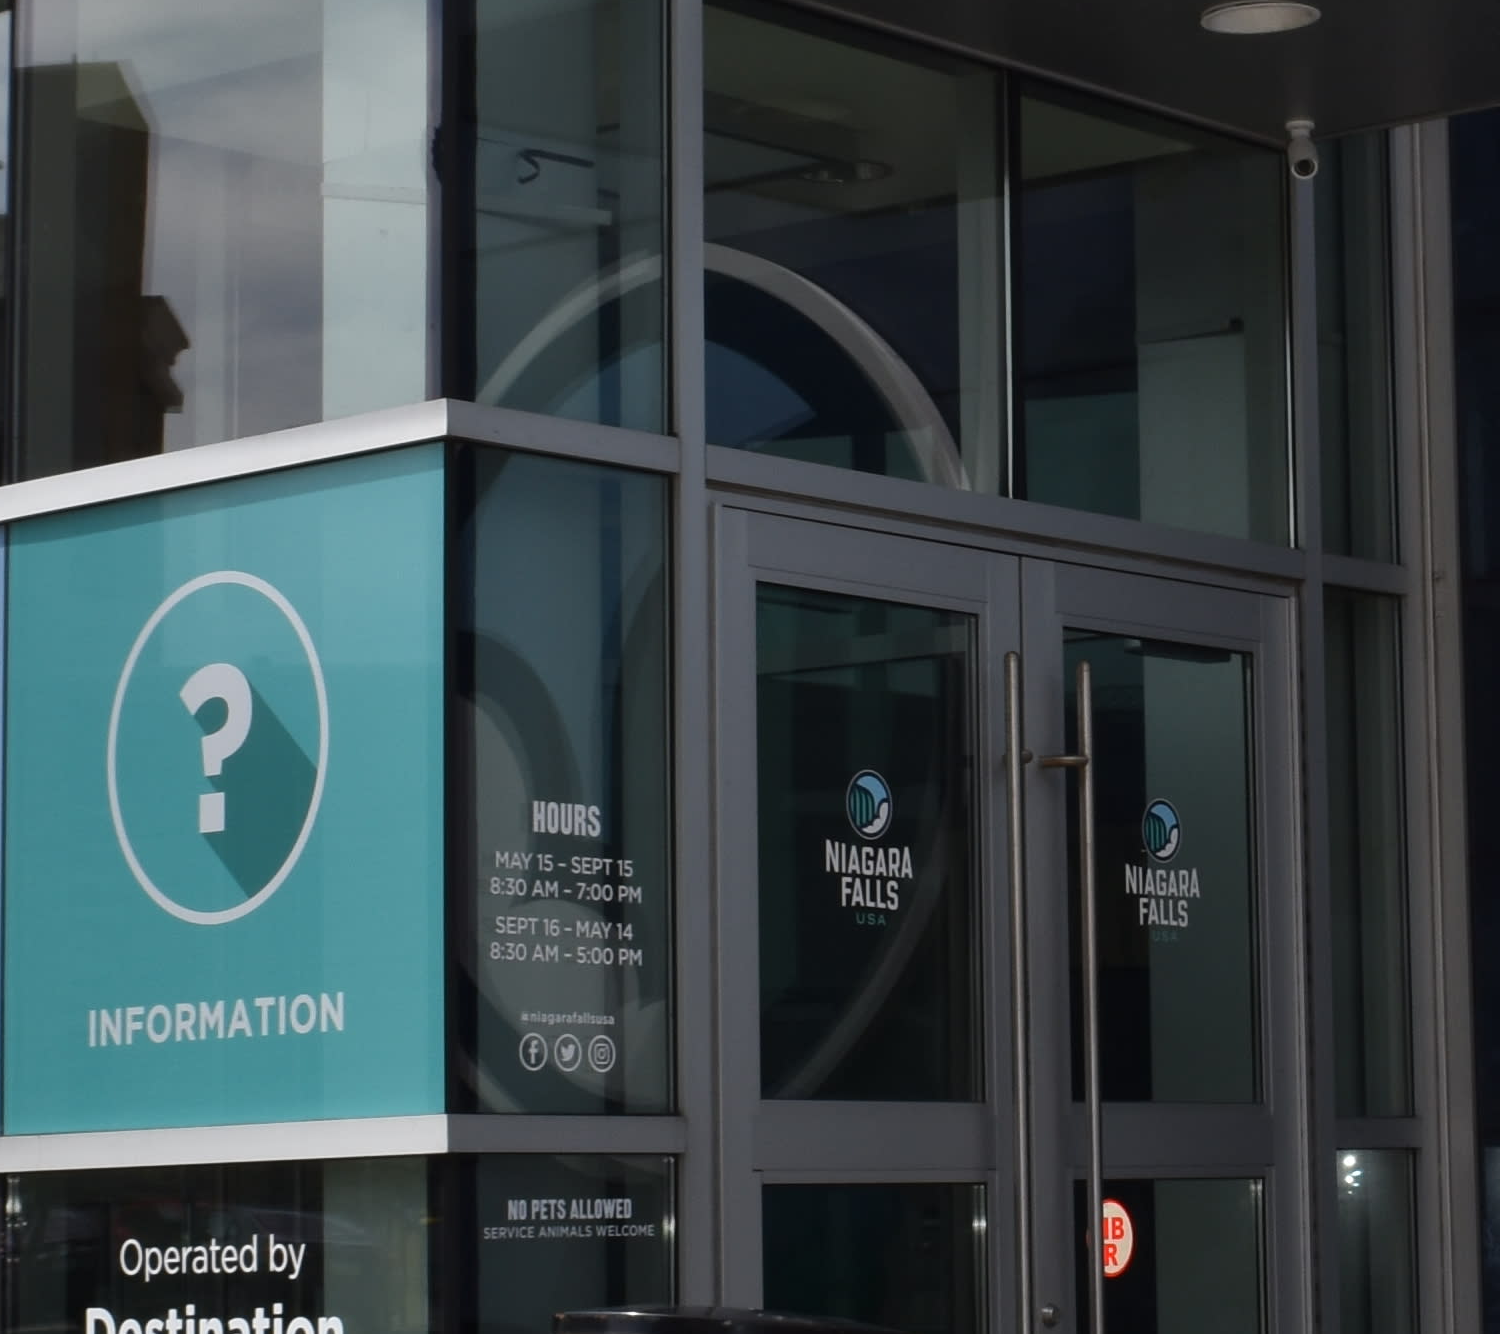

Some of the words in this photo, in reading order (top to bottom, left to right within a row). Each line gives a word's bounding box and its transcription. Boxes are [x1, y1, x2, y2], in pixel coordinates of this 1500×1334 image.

[532, 800, 601, 837] HOURS
[495, 851, 533, 870] MAY
[537, 854, 554, 872] 15
[571, 856, 612, 875] SEPT
[617, 860, 633, 877] 15
[825, 838, 913, 879] NIAGARA
[490, 877, 527, 896] 8:30
[532, 880, 559, 898] AM
[576, 882, 613, 902] 7:00
[618, 885, 642, 904] PM
[841, 876, 899, 910] FALLS
[1125, 863, 1200, 898] NIAGARA
[856, 913, 886, 925] USA
[1139, 897, 1189, 927] FALLS
[495, 916, 538, 935] SEPT
[543, 919, 560, 937] 16
[576, 920, 612, 939] MAY
[616, 923, 633, 941] 14
[490, 942, 527, 961] 8:30
[532, 944, 559, 963] AM
[576, 946, 613, 965] 5:00
[618, 948, 643, 967] PM
[88, 992, 345, 1047] INFORMATION
[508, 1199, 527, 1220] NO
[531, 1199, 566, 1220] PETS
[570, 1198, 632, 1220] ALLOWED
[483, 1226, 535, 1240] SERVICE
[538, 1225, 593, 1238] ANIMALS
[595, 1224, 655, 1238] WELCOME
[119, 1234, 258, 1282] Operated
[269, 1234, 306, 1280] by
